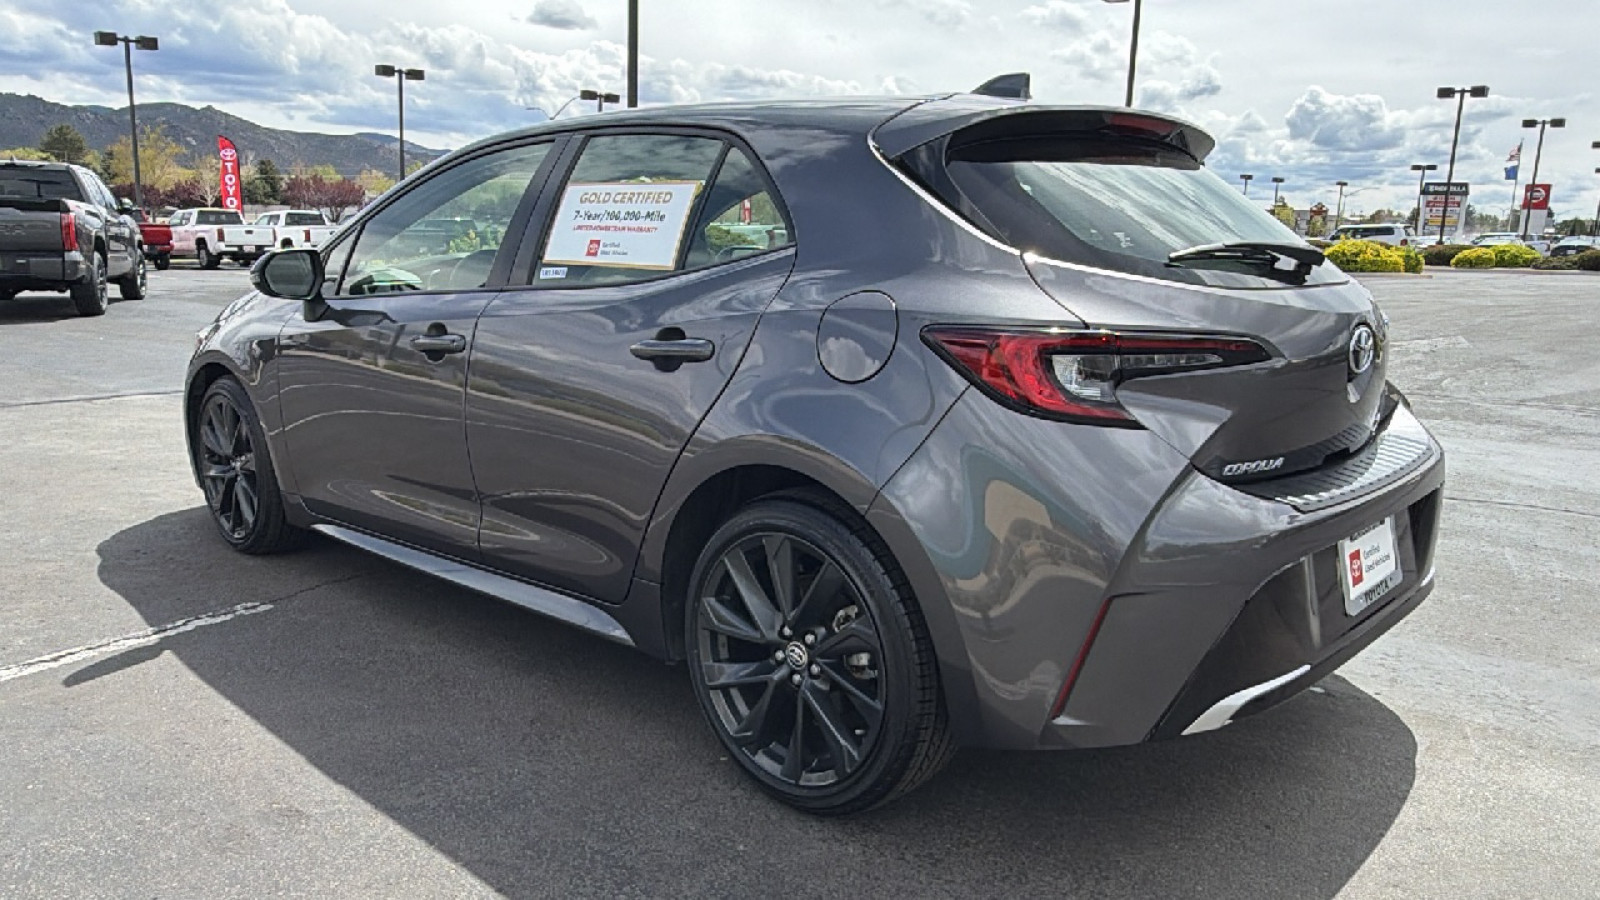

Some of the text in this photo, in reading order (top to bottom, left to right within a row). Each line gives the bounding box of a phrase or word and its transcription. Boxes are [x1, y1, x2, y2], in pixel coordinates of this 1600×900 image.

[579, 191, 673, 204] GOLD CERTIFIED
[1222, 457, 1285, 475] COROLLA
[1364, 578, 1390, 604] TOYOTA
